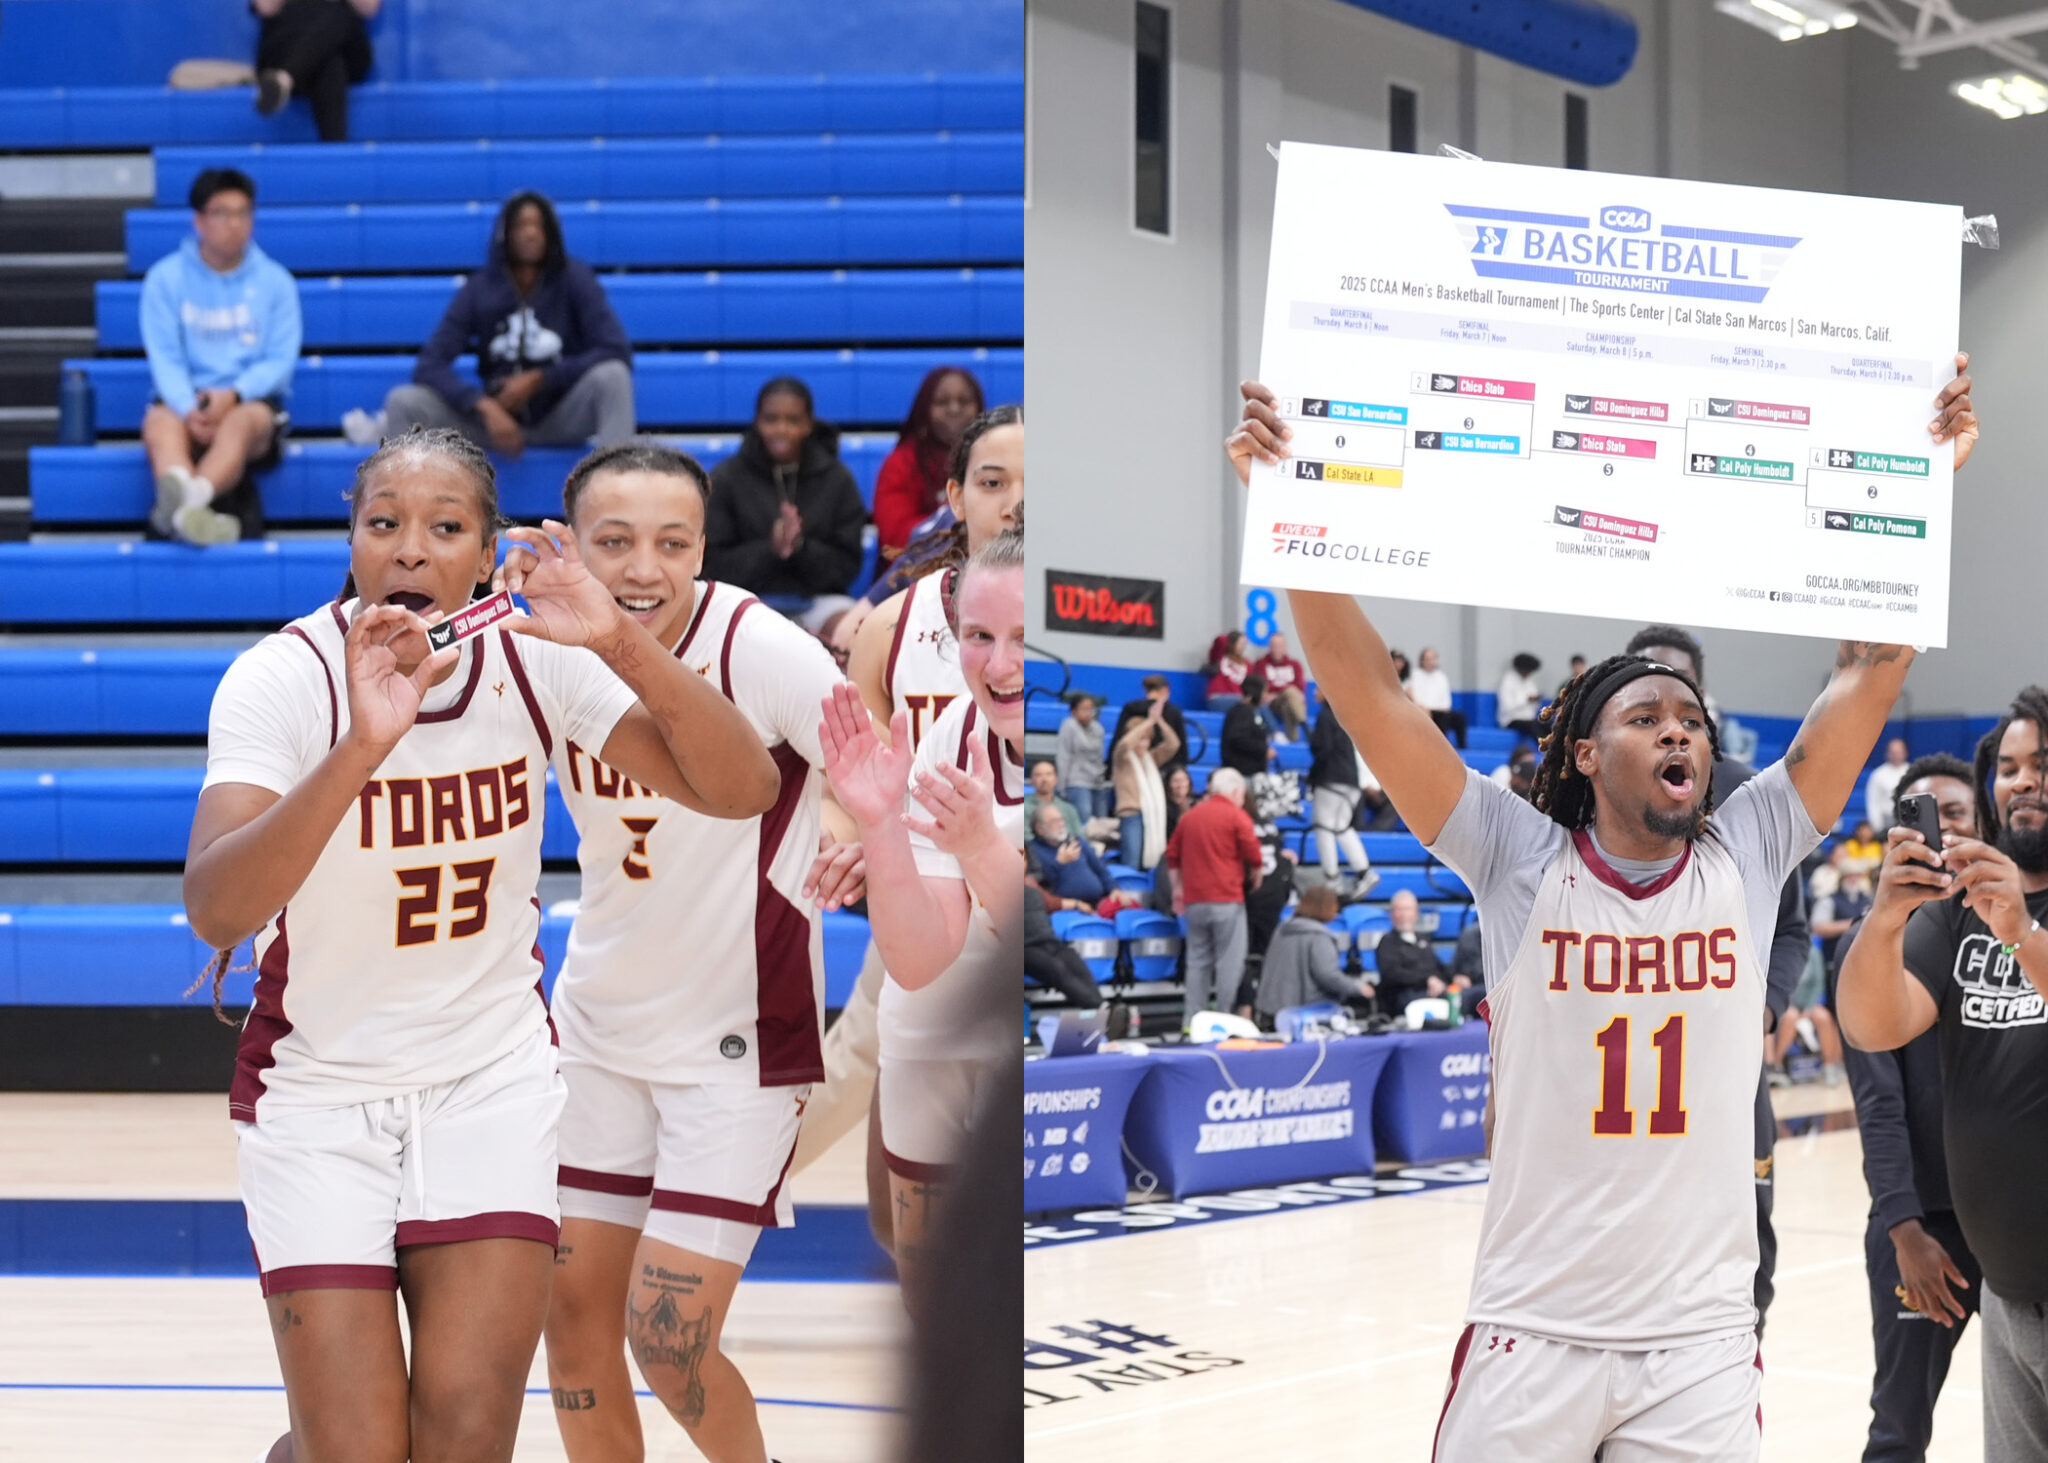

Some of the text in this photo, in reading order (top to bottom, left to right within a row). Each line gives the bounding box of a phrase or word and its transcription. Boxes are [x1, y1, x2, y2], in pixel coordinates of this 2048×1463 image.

[1603, 209, 1648, 230] CCAA
[1523, 229, 1749, 281] BASKETBALL
[1574, 270, 1670, 293] TOURNAMENT
[1330, 308, 1373, 321] QUARTERFINAL
[1340, 275, 1367, 292] 2025
[1370, 278, 1398, 295] CCAA
[1401, 282, 1433, 298] Men's
[1436, 284, 1493, 304] Basketball
[1497, 290, 1559, 311] Tournament
[1570, 297, 1589, 313] The
[1592, 299, 1626, 319] Sports
[1630, 303, 1665, 321] Center
[1675, 307, 1692, 324] Cal
[1695, 310, 1722, 326] State
[1725, 313, 1745, 329] San
[1749, 314, 1787, 333] Marcos
[1797, 319, 1817, 335] San
[1865, 326, 1892, 343] Calif.
[1373, 322, 1389, 332] Noon
[1458, 320, 1489, 332] SEMIFINAL
[1492, 333, 1507, 343] Noon
[1585, 332, 1636, 346] CHAMPIONSHIP
[1599, 345, 1621, 356] March
[1734, 346, 1765, 358] SEMIFINAL
[1732, 356, 1750, 366] March
[1851, 357, 1893, 370] QUARTERFINAL
[1859, 369, 1877, 378] March
[1460, 379, 1505, 395] Chico State
[1331, 404, 1403, 422] CSU San Bernardino
[1594, 400, 1665, 418] CSU Dominguez Hills
[1737, 404, 1807, 421] CSU Dominguez Hills
[1444, 435, 1515, 451] CSU San Bernardino
[1582, 437, 1626, 453] Chico State
[1720, 460, 1790, 478] Cal Poly Humboldt
[1857, 454, 1926, 473] Cal Poly Humboldt
[1326, 467, 1374, 483] Cal State LA
[1279, 524, 1321, 537] LIVE ON
[1583, 514, 1654, 539] CSU Dominguez Hills
[1853, 517, 1917, 535] Cal Poly Pomona
[1556, 541, 1650, 561] TOURNAMENT CHAMPION
[1805, 574, 1919, 597] GOCCAA.ORG/MBBTOURNEY
[1052, 583, 1156, 627] Wilson
[454, 617, 469, 636] CSU
[495, 597, 510, 615] Hills
[1245, 588, 1279, 647] 8
[357, 755, 531, 850] TOROS
[392, 855, 498, 950] 23
[1541, 926, 1737, 994] TOROS
[1591, 1011, 1690, 1138] 11
